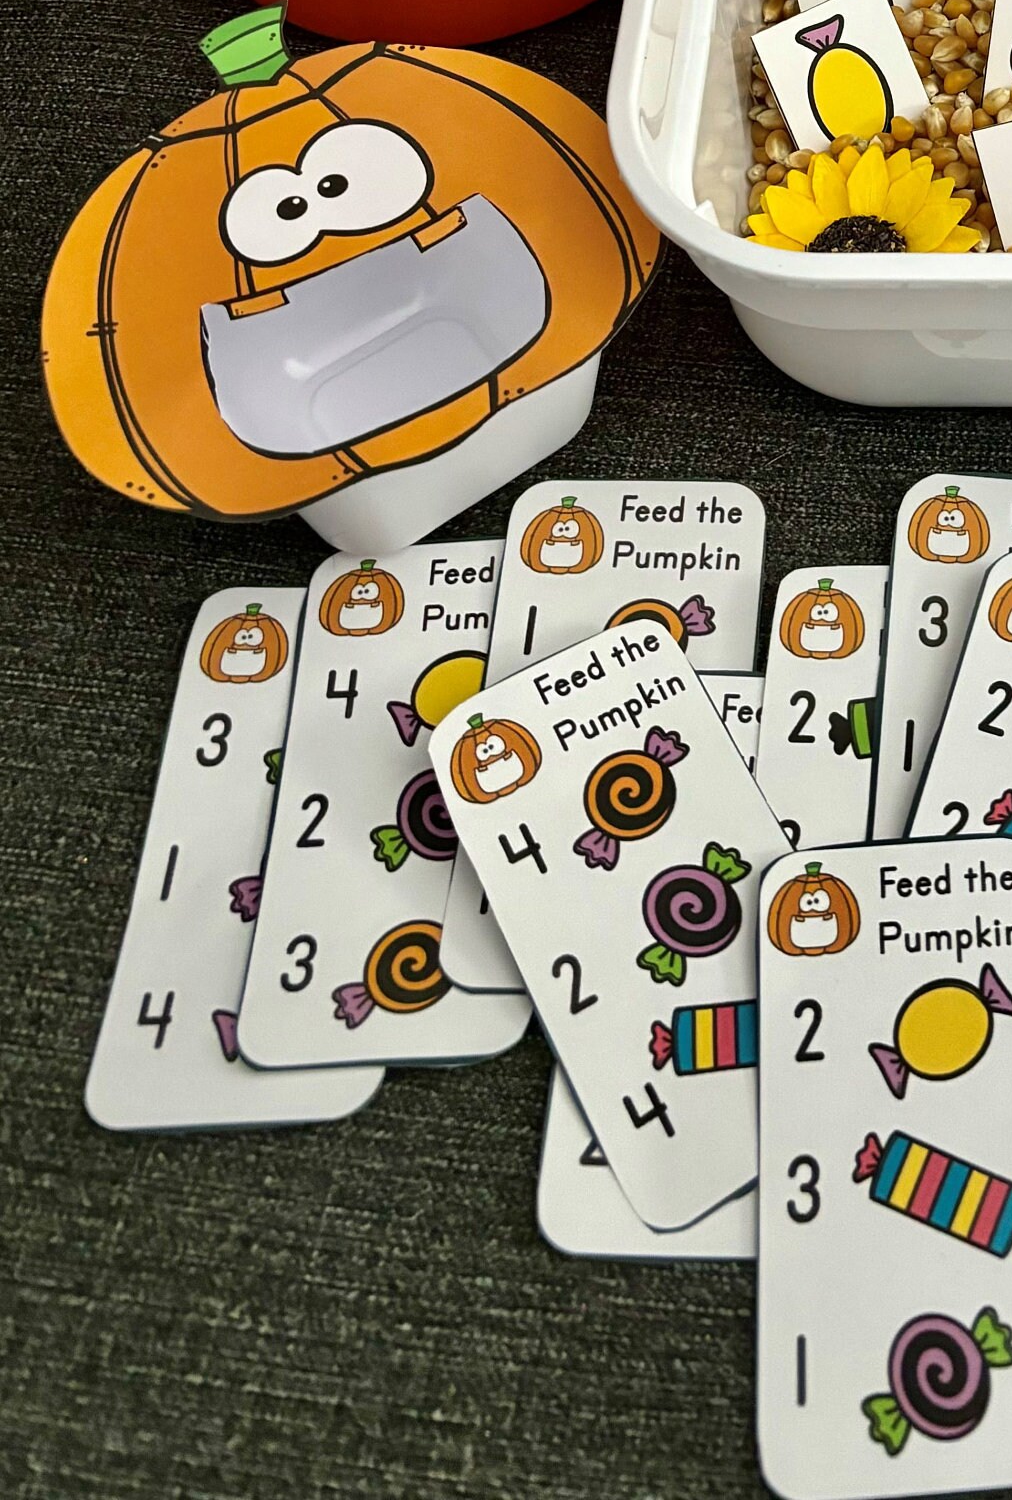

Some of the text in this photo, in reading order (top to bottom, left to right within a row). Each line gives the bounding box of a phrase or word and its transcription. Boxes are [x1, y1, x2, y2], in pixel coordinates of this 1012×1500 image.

[620, 494, 743, 525] Feed the
[429, 555, 496, 586] Feed
[612, 540, 741, 581] Pumpkin
[421, 604, 490, 632] Pum
[523, 605, 538, 656] 1
[918, 595, 949, 648] 3
[325, 668, 359, 720] 4
[533, 634, 660, 706] Feed the
[552, 670, 686, 752] Pumpkin
[787, 690, 816, 744] 2
[195, 712, 233, 768] 3
[903, 719, 915, 772] 1
[295, 793, 330, 849] 2
[497, 823, 548, 875] 4
[159, 844, 179, 902] 1
[879, 862, 952, 899] Feed
[279, 934, 318, 993] 3
[551, 953, 599, 1016] 2
[136, 990, 175, 1050] 4
[793, 998, 825, 1063] 2
[622, 1082, 676, 1138] 4
[786, 1154, 821, 1225] 3
[796, 1334, 807, 1408] 1
